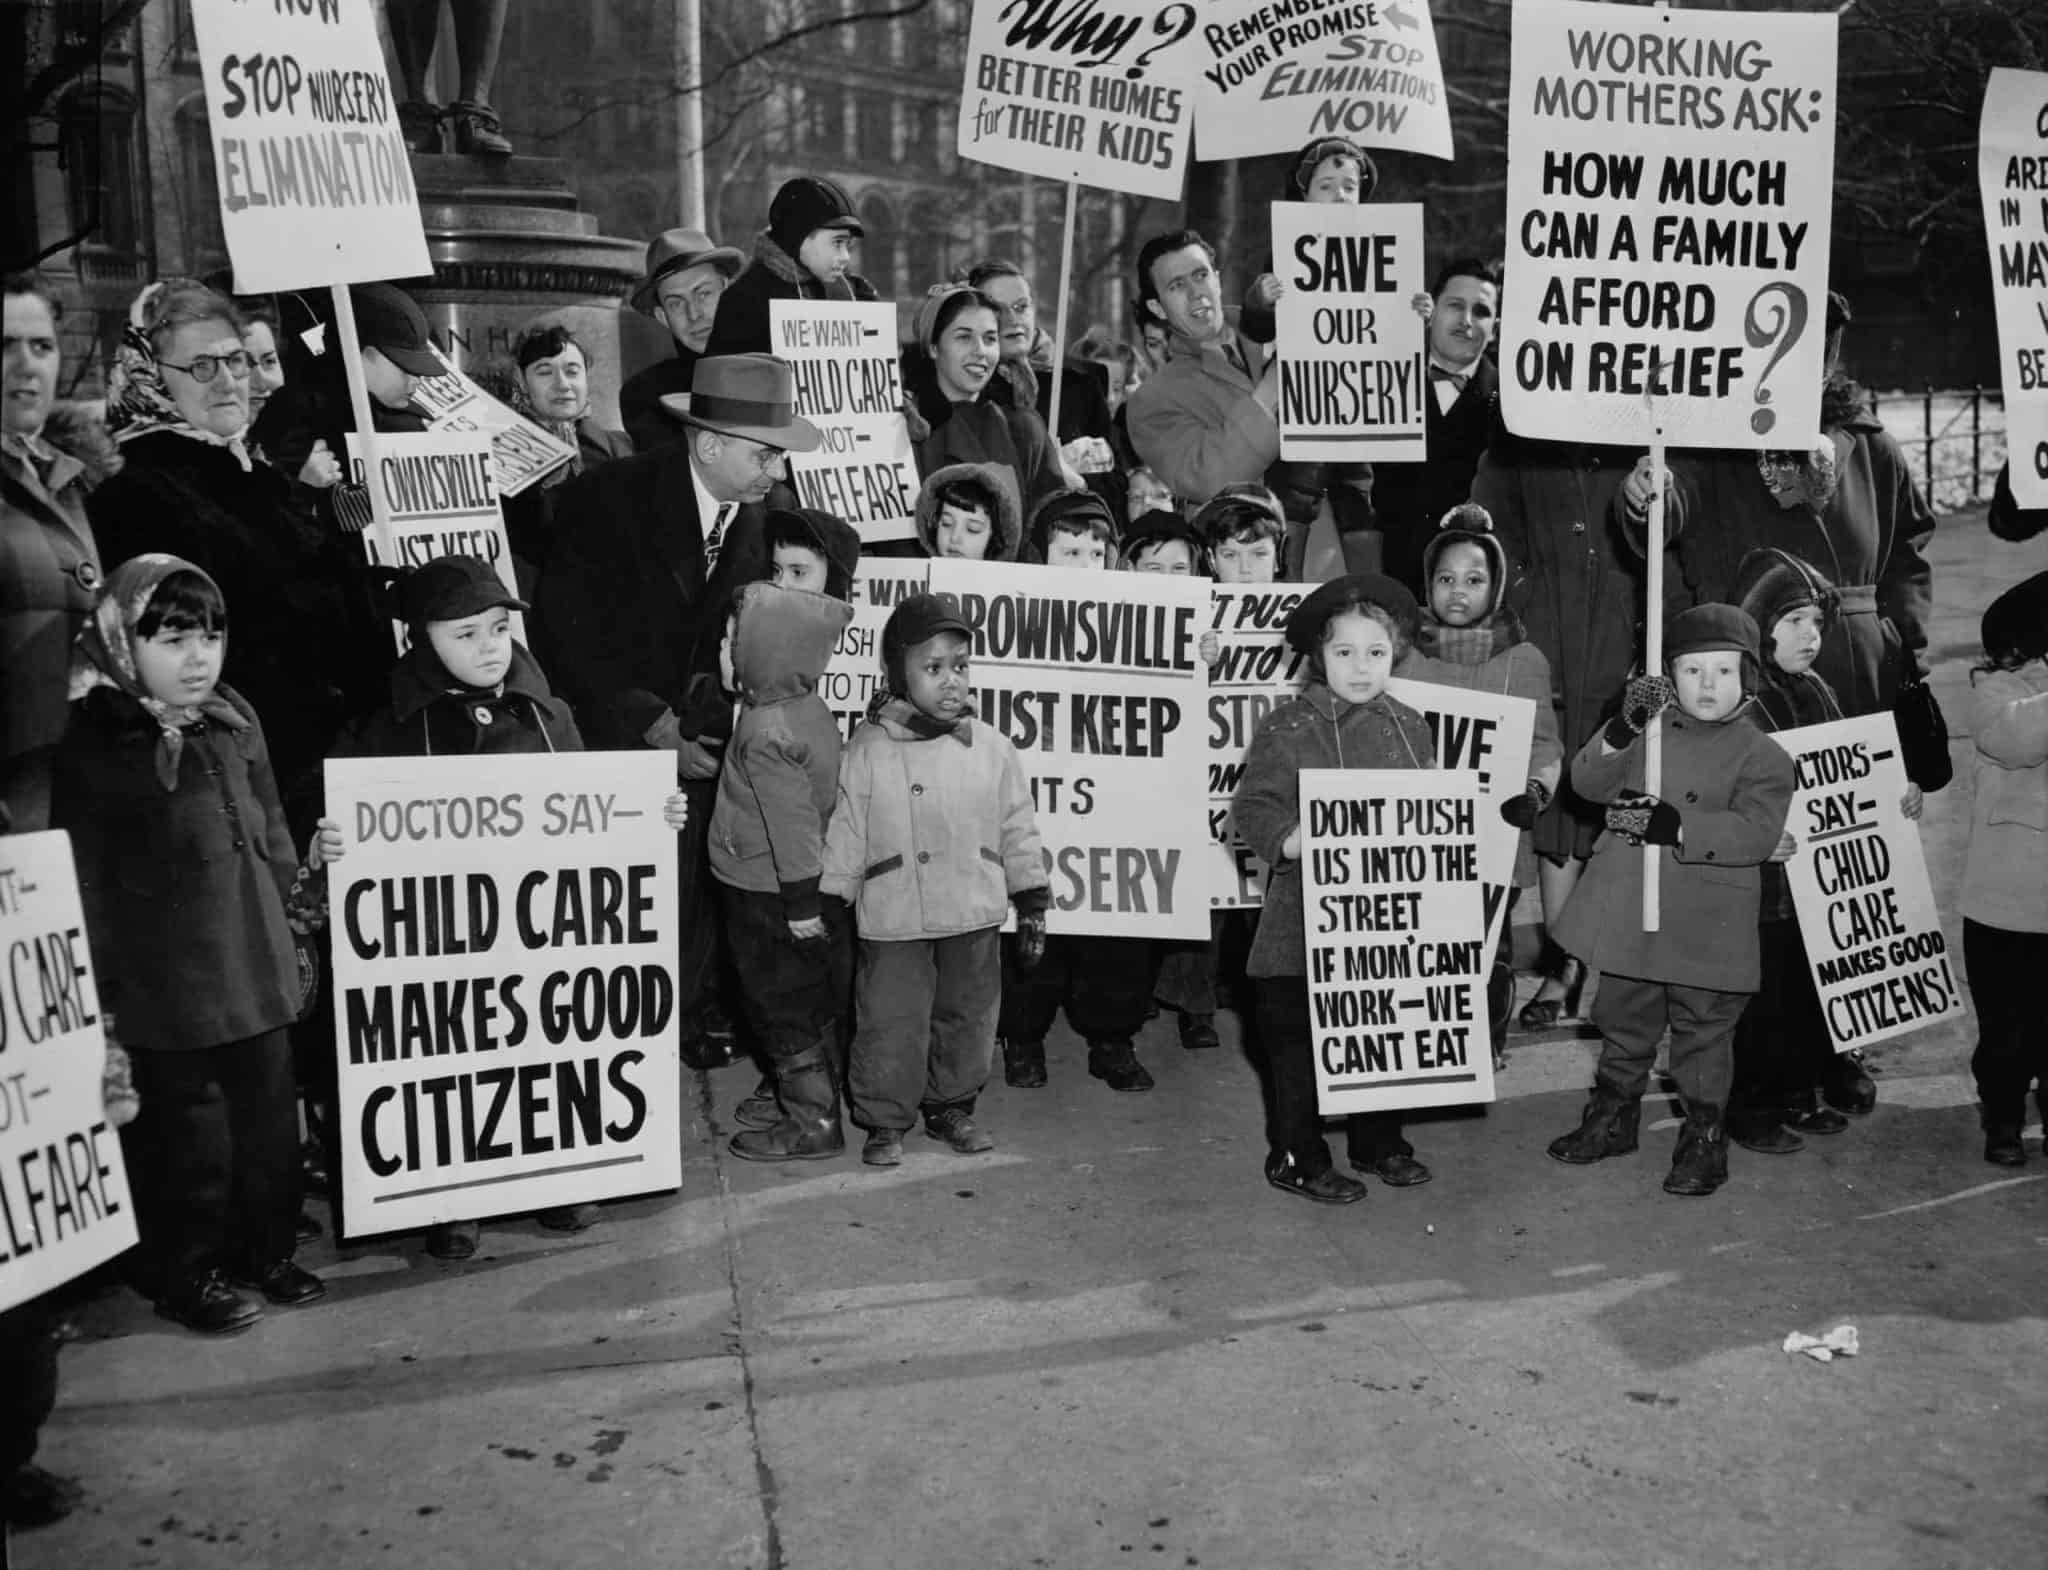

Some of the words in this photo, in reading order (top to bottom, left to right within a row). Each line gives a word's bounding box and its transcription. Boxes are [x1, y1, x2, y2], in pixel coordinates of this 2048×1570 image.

[1204, 44, 1271, 94] YOUR
[1268, 3, 1379, 57] PROMISE
[1325, 34, 1424, 67] STOP
[1567, 28, 1772, 82] WORKING
[221, 53, 301, 119] STOP
[307, 69, 388, 125] NURSERY
[977, 54, 1081, 105] BETTER
[1088, 75, 1183, 124] HOMES
[1260, 61, 1437, 106] ELIMINATIONS
[1533, 76, 1725, 130] MOTHERS
[1732, 86, 1821, 133] ASK:
[971, 97, 1006, 143] for
[1007, 103, 1086, 152] THEIR
[1098, 120, 1174, 170] KIDS
[1309, 98, 1408, 135] NOW
[221, 130, 412, 212] ELIMINATION
[1543, 150, 1644, 200] HOW
[1658, 156, 1786, 206] MUCH
[1294, 234, 1397, 292] SAVE
[1521, 209, 1599, 259] CAN
[1608, 214, 1638, 262] A
[1652, 215, 1808, 271] FAMILY
[782, 319, 810, 347] WE
[1313, 308, 1377, 344] OUR
[1537, 276, 1715, 332] AFFORD
[846, 358, 904, 414] CARE
[1280, 352, 1422, 425] NURSERY!
[1515, 338, 1573, 392] ON
[1588, 341, 1744, 398] RELIEF
[797, 462, 914, 523] WELFARE
[1071, 693, 1180, 758] KEEP
[1794, 742, 1893, 791] CTORS—
[356, 793, 524, 843] DOCTORS
[1310, 798, 1386, 838] DONT
[1397, 799, 1475, 836] PUSH
[1312, 847, 1350, 885] US
[1361, 845, 1426, 884] INTO
[1431, 844, 1478, 882] THE
[1813, 834, 1890, 896] CHILD
[344, 873, 499, 961] CHILD
[515, 864, 658, 950] CARE
[1317, 891, 1422, 933] STREET
[1828, 887, 1906, 951] CARE
[9, 927, 97, 1044] CARE
[1312, 947, 1335, 983] IF
[1417, 941, 1483, 977] CANT
[1816, 945, 1887, 987] MAKES
[1888, 930, 1946, 967] GOOD
[345, 974, 528, 1065] MAKES
[539, 964, 673, 1044] GOOD
[1827, 958, 1960, 1042] CITIZENS!
[1321, 1031, 1404, 1076] CANT
[1415, 1027, 1469, 1069] EAT
[361, 1050, 647, 1177] CITIZENS
[0, 1121, 120, 1265] LFARE
